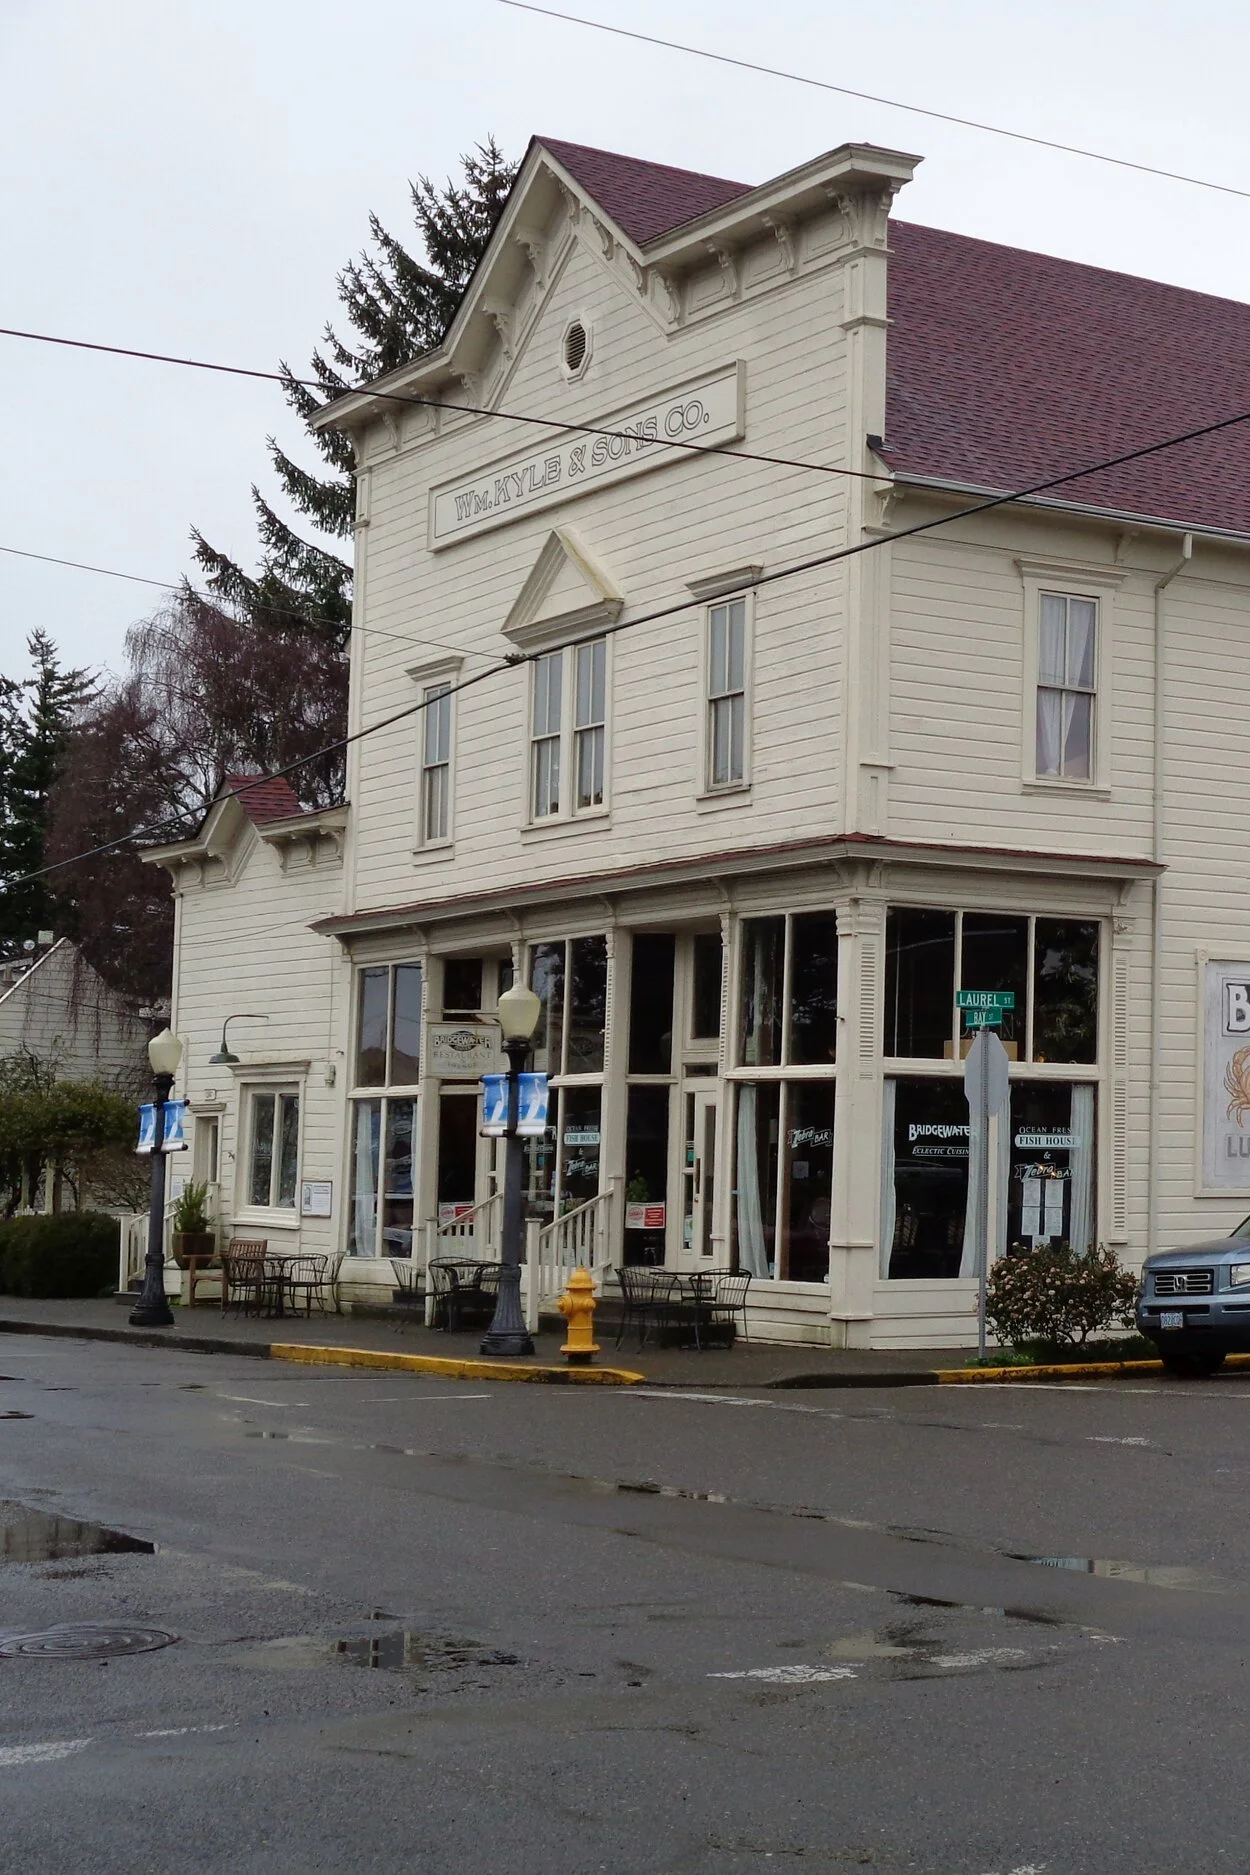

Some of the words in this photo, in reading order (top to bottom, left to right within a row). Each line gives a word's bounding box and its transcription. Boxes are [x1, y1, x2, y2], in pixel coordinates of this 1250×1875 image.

[567, 445, 586, 477] &
[591, 416, 658, 467] SONS
[664, 400, 710, 437] CO.
[959, 993, 1000, 1006] LAUREL
[973, 1011, 987, 1025] BAY
[433, 1034, 491, 1049] BRIDGEWATER
[432, 1051, 492, 1059] RESTAURANT
[1019, 1126, 1047, 1134] OCEAN
[1052, 1126, 1072, 1134] FRES
[814, 1131, 829, 1143] BAR
[1019, 1136, 1041, 1146] FISH
[912, 1147, 945, 1155] ECLECTIC
[1043, 1151, 1052, 1160] &
